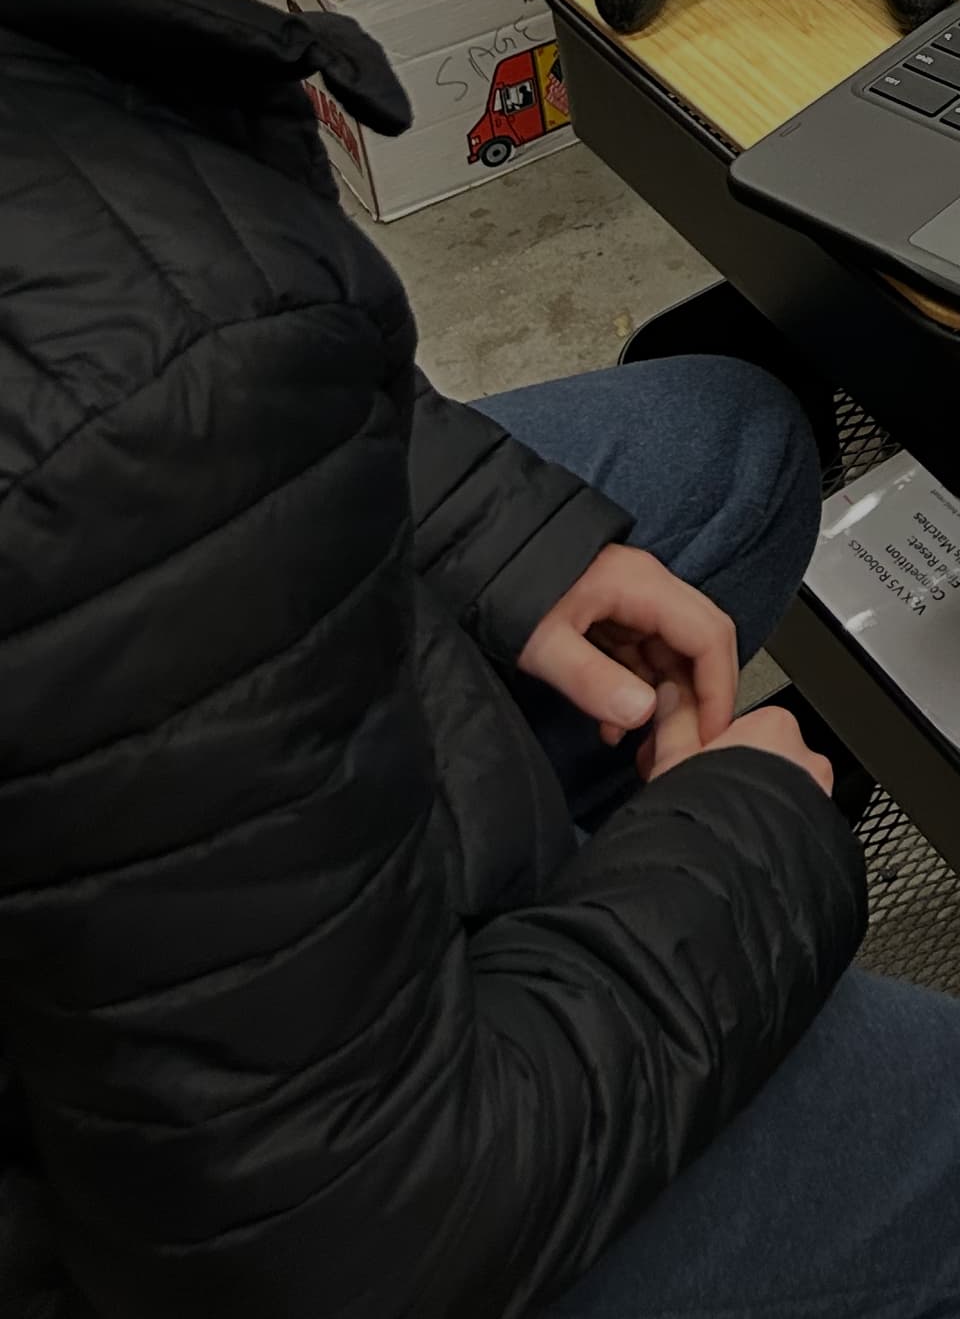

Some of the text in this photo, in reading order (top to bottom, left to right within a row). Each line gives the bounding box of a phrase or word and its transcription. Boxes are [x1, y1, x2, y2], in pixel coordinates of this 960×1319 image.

[435, 15, 546, 102] SAGE
[906, 535, 940, 568] Reset:
[912, 511, 957, 555] Matches
[848, 538, 891, 583] Robotics
